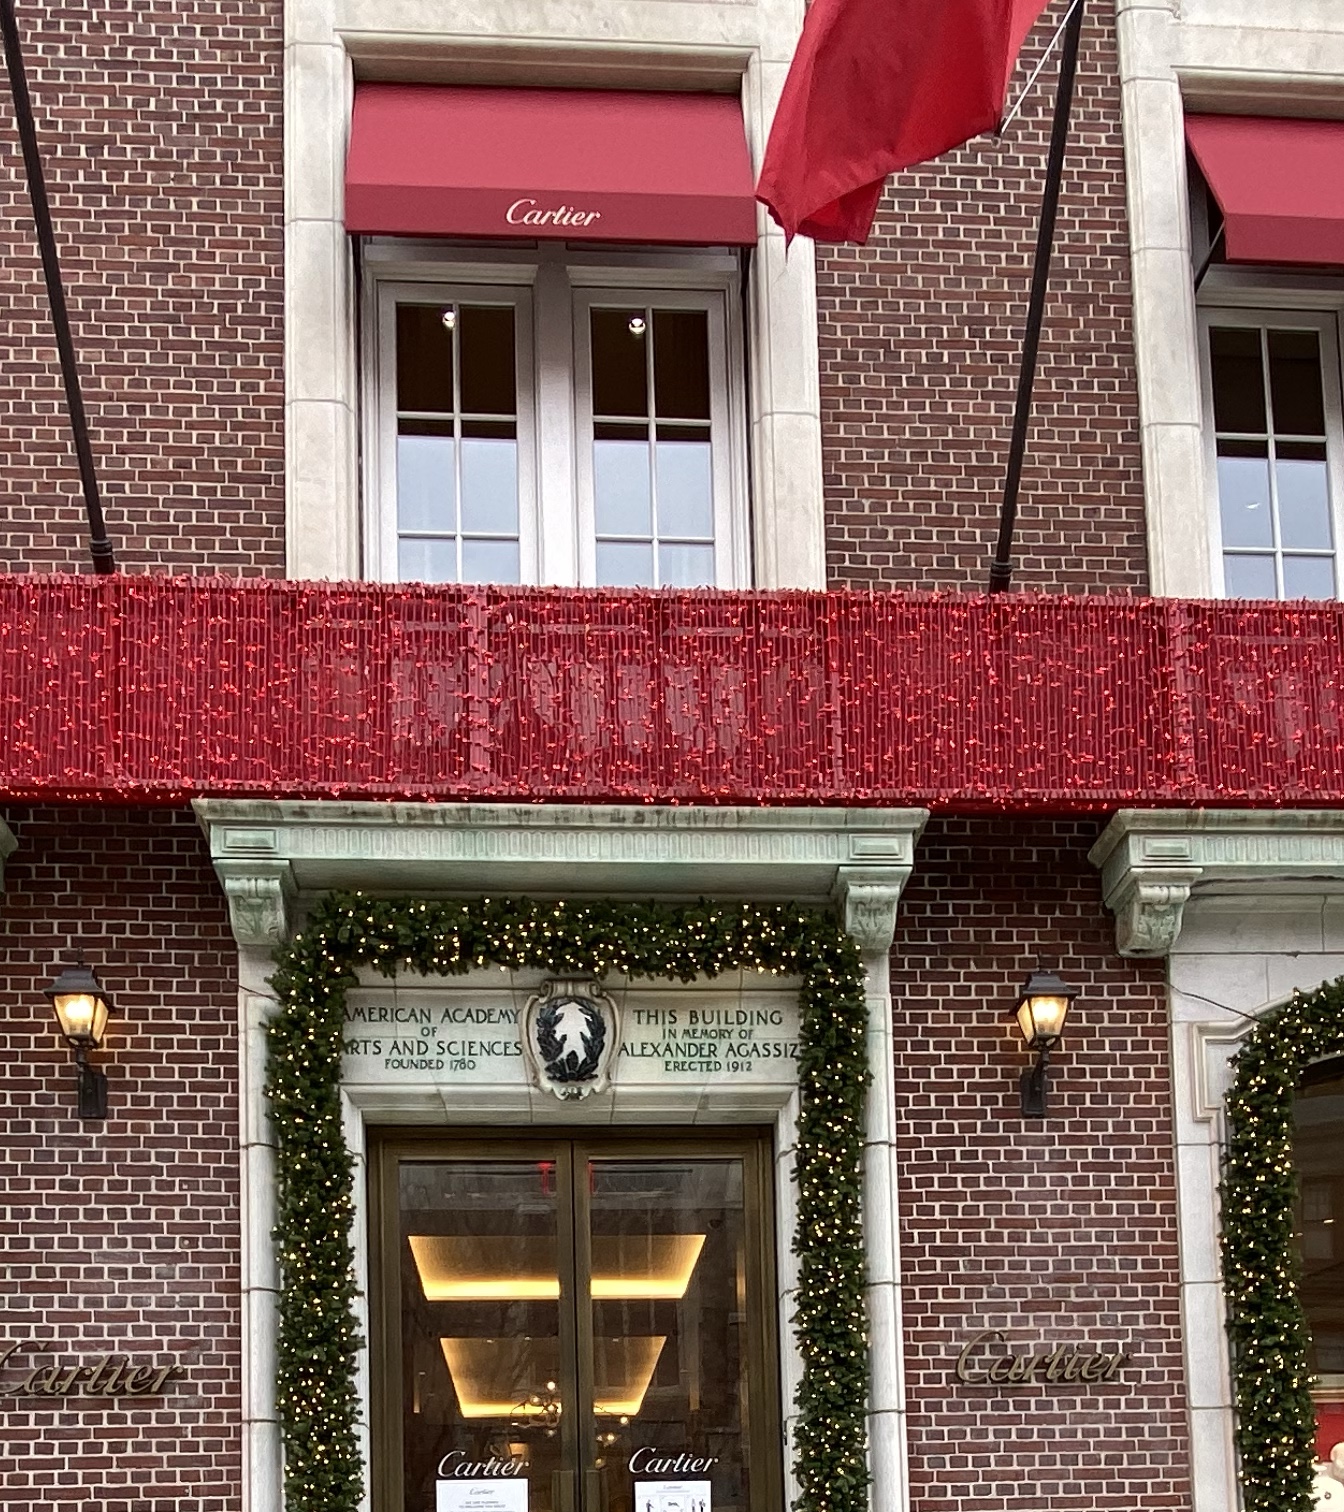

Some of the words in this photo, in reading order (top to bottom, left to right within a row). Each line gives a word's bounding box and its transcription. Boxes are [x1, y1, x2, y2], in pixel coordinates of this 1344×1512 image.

[506, 198, 602, 226] Cartier
[342, 1006, 431, 1024] AMERICAN
[440, 1007, 522, 1025] ACADEMY
[632, 1009, 678, 1026] THIS
[688, 1009, 784, 1027] BUILDING
[420, 1026, 438, 1038] OF
[662, 1028, 677, 1040] IN
[681, 1028, 735, 1040] MEMORY
[738, 1028, 755, 1040] OF
[388, 1040, 429, 1057] AND
[436, 1040, 523, 1058] SCIENCES
[617, 1042, 718, 1058] ALEXANDER
[724, 1042, 799, 1059] AGASSIZ
[384, 1058, 445, 1071] FOUNDED
[449, 1058, 477, 1072] 1780
[664, 1060, 722, 1073] ERECTED
[726, 1060, 753, 1073] 1912
[956, 1329, 1134, 1384] Cartier
[437, 1450, 530, 1478] Cartier
[628, 1446, 720, 1474] Cartier
